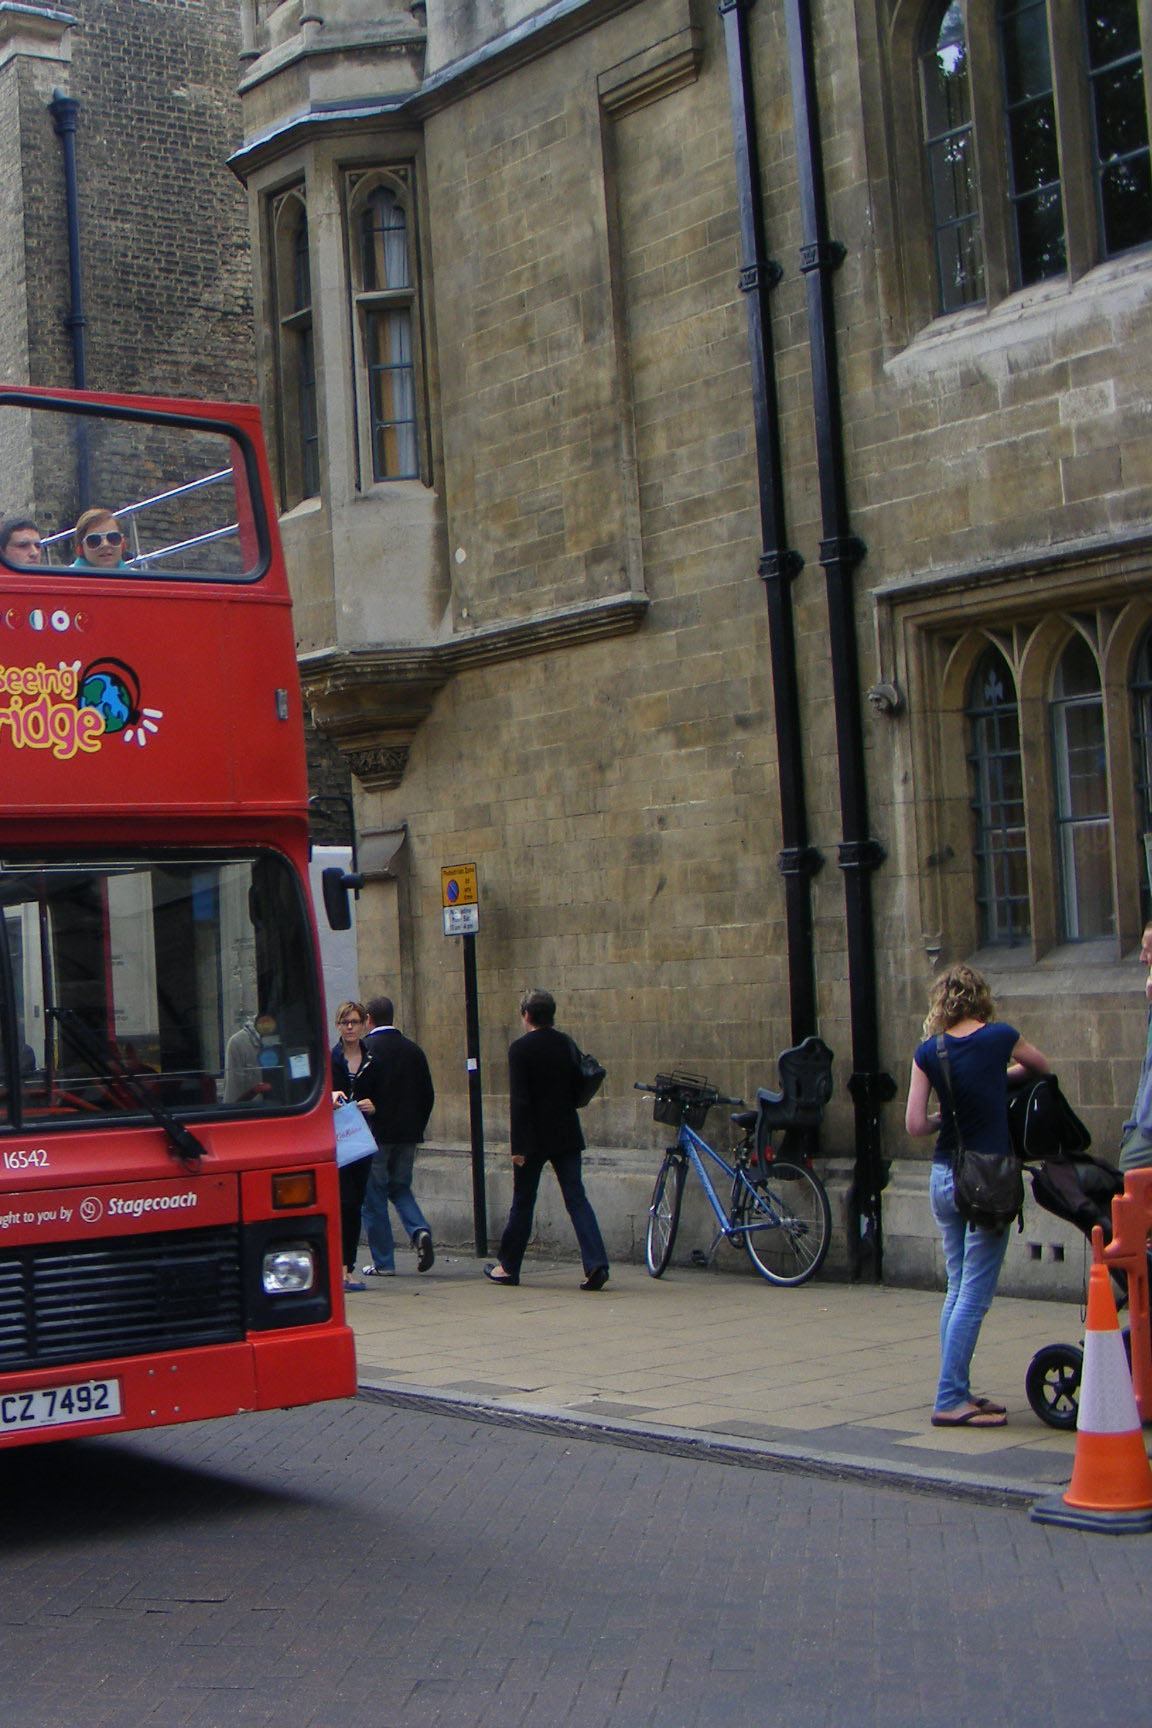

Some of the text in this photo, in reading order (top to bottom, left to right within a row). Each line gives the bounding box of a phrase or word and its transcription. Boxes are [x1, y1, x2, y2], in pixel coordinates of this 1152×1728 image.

[3, 1149, 50, 1169] 16542
[23, 1211, 35, 1224] to
[37, 1211, 56, 1226] you
[59, 1205, 73, 1223] by
[108, 1191, 197, 1217] Stagecoach
[42, 1382, 109, 1418] 7492
